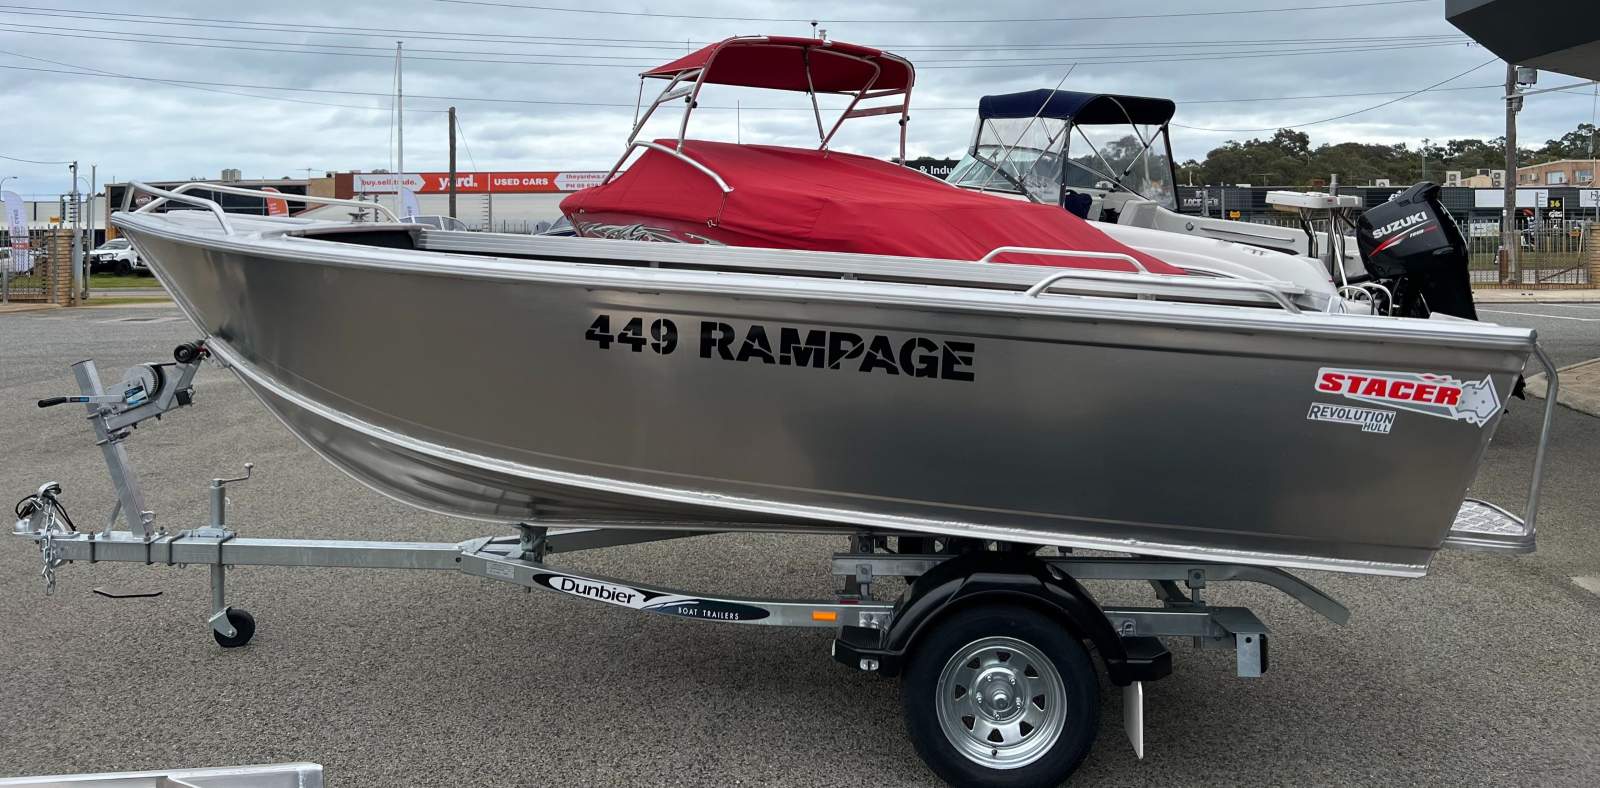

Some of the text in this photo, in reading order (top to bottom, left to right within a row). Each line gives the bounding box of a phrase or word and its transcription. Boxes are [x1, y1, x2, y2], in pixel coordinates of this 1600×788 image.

[920, 165, 927, 173] &
[494, 177, 549, 186] USED CARS
[1372, 211, 1428, 239] SUZUKI
[585, 314, 975, 382] 449 RAMPAGE
[1318, 372, 1462, 406] STACER
[1308, 405, 1395, 425] REVOLUTION
[1362, 422, 1390, 433] HULL
[560, 577, 636, 604] Dunbier
[678, 606, 740, 620] BOAT TRAILERS
